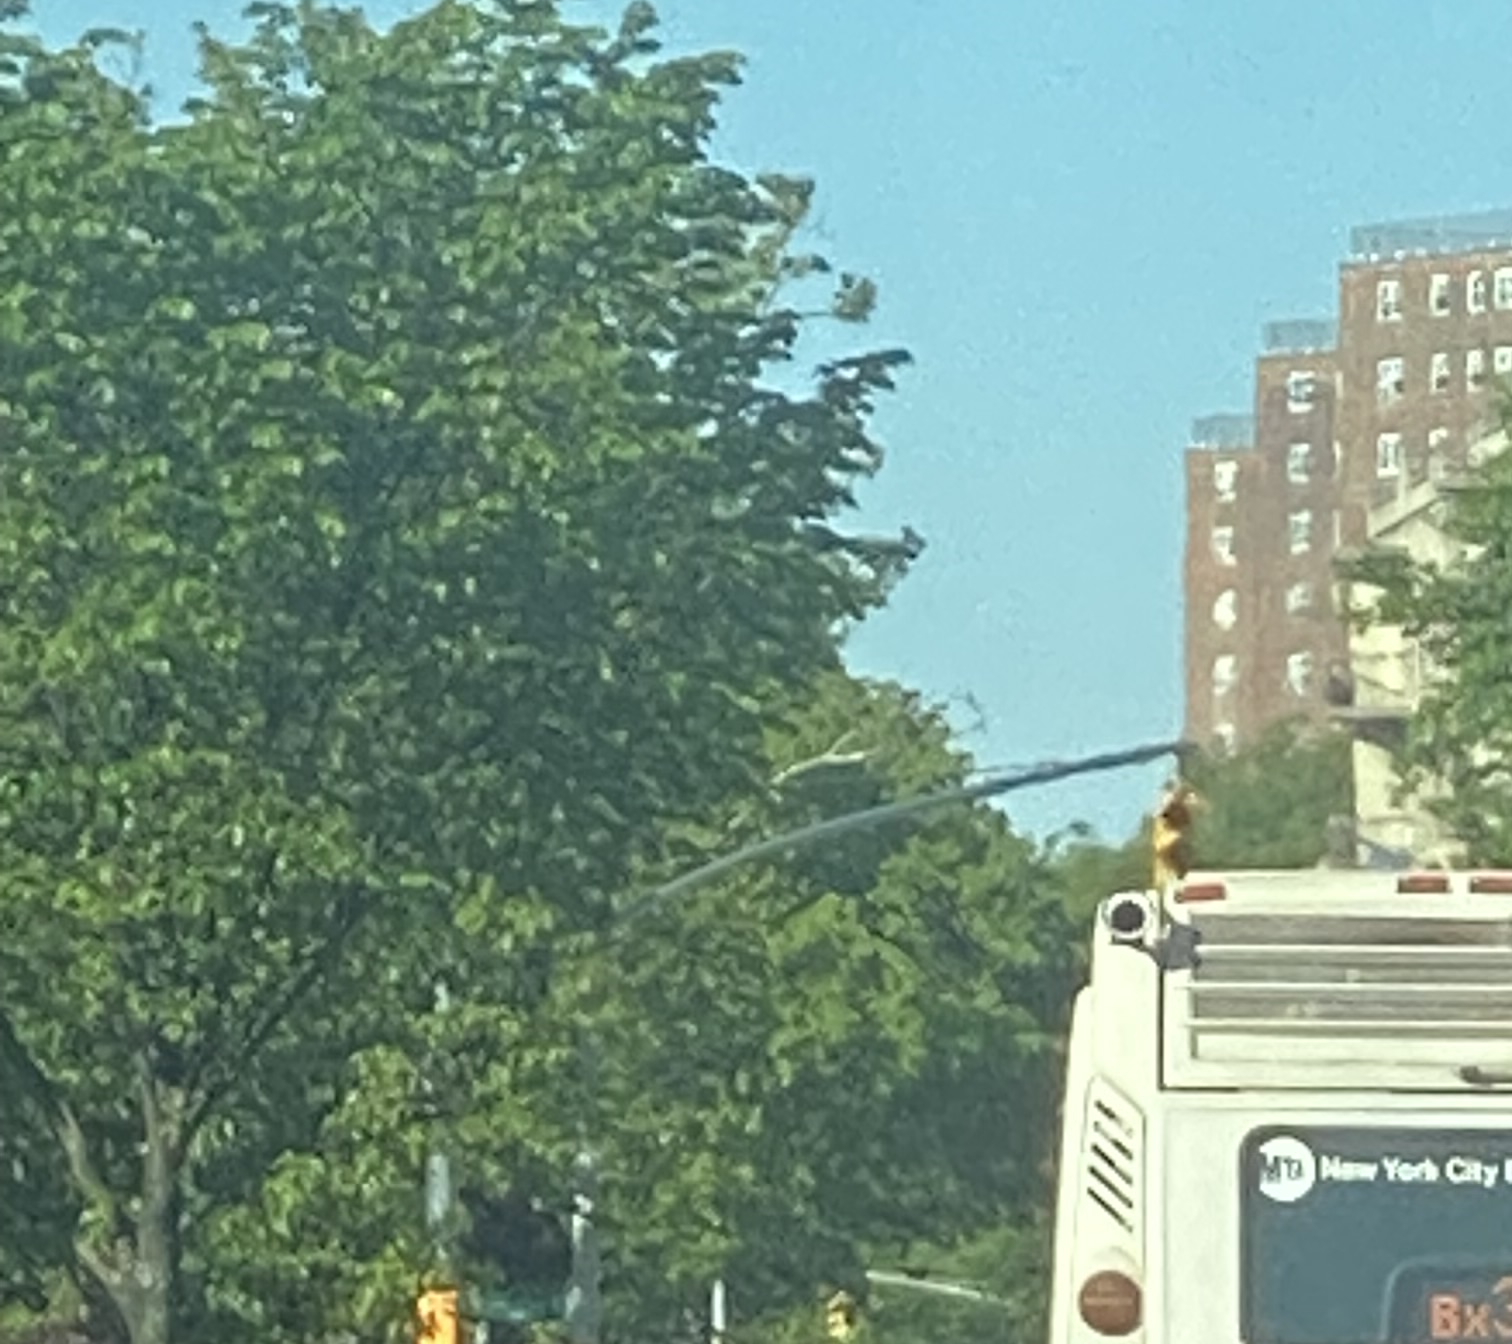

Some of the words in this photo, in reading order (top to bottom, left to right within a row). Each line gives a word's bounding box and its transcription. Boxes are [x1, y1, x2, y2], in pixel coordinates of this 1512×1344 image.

[1321, 1156, 1377, 1180] New
[1382, 1156, 1438, 1181] York
[1445, 1156, 1499, 1188] City
